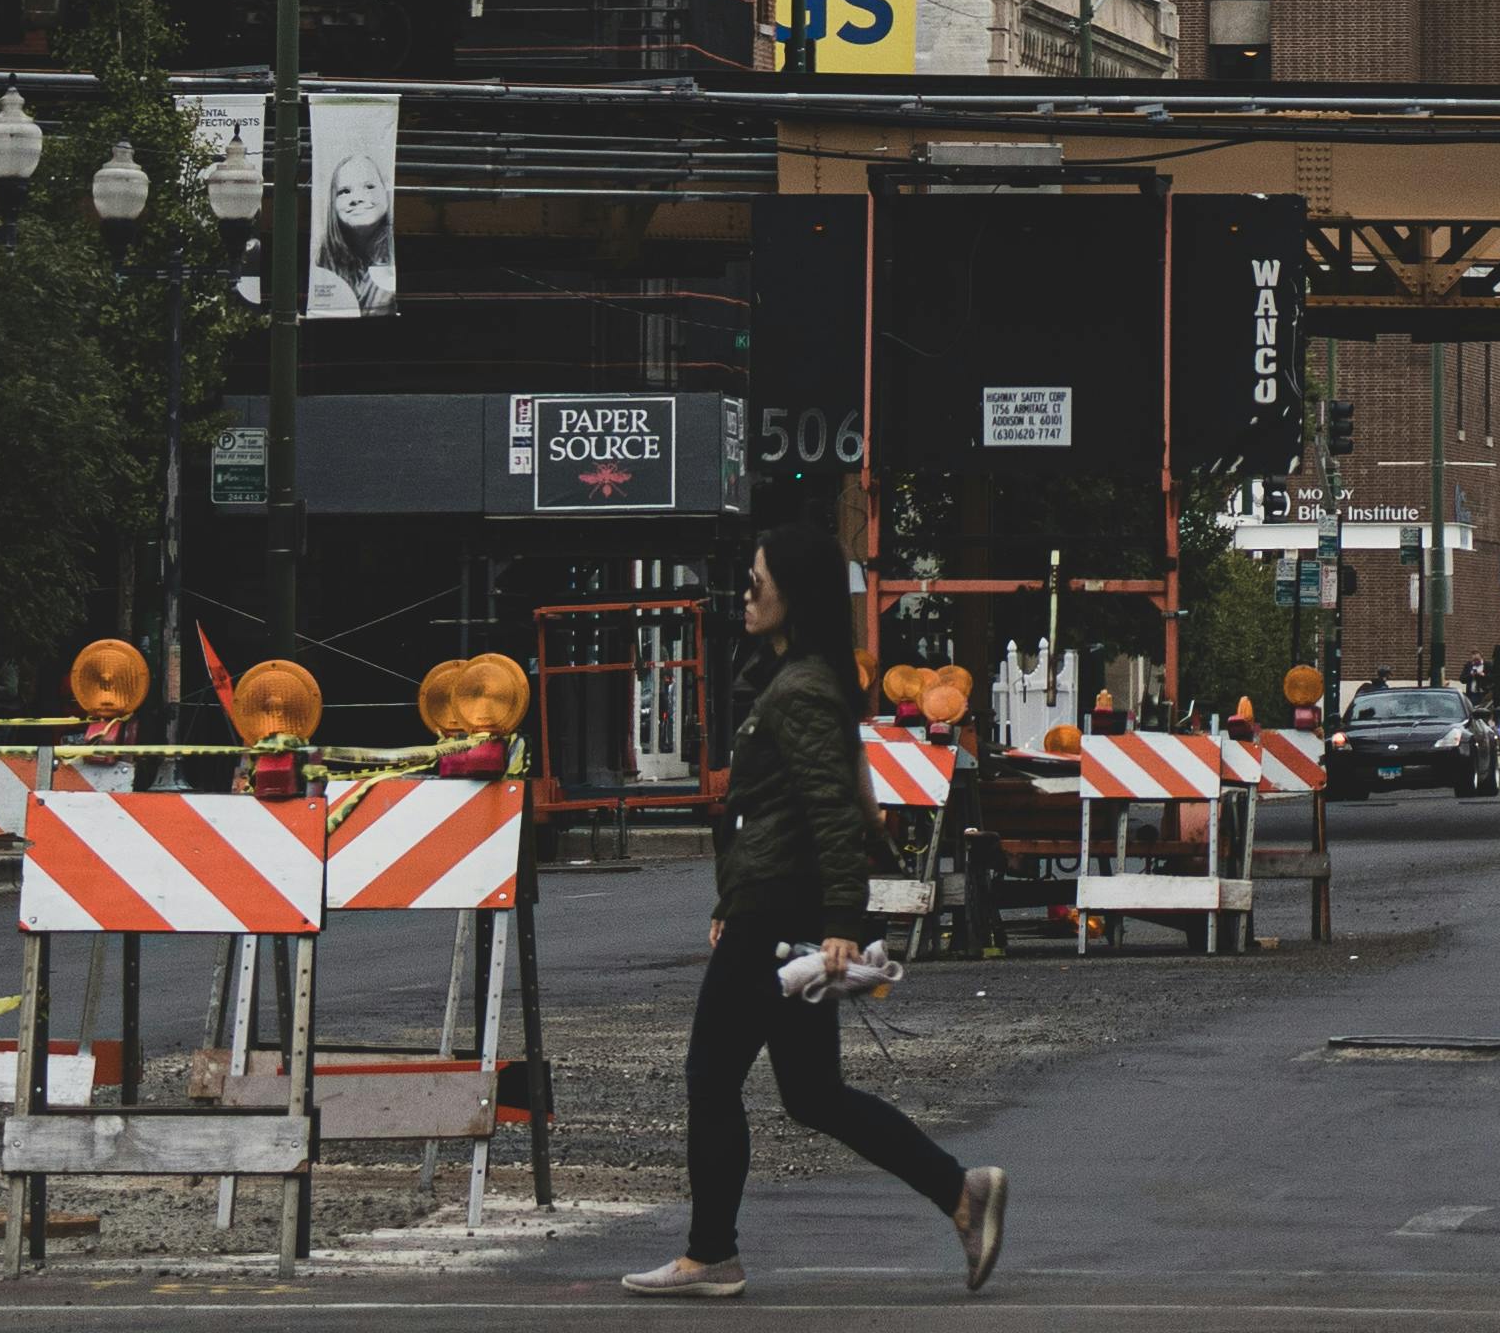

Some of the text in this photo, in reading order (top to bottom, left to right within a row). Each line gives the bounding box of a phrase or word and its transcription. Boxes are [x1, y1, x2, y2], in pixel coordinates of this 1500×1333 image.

[1252, 259, 1281, 404] WANCO
[986, 392, 1067, 402] HIGHWAY SAFETY CORP
[992, 404, 1061, 414] 1756 ARMITAGE CT
[559, 409, 650, 433] PAPER
[992, 416, 1025, 426] ADDISON
[1040, 416, 1062, 426] 60101
[761, 407, 863, 463] 506
[993, 428, 1061, 440] (630)620-7747
[550, 436, 661, 460] SOURCE
[1298, 488, 1354, 500] MODY
[1348, 503, 1419, 521] Institute
